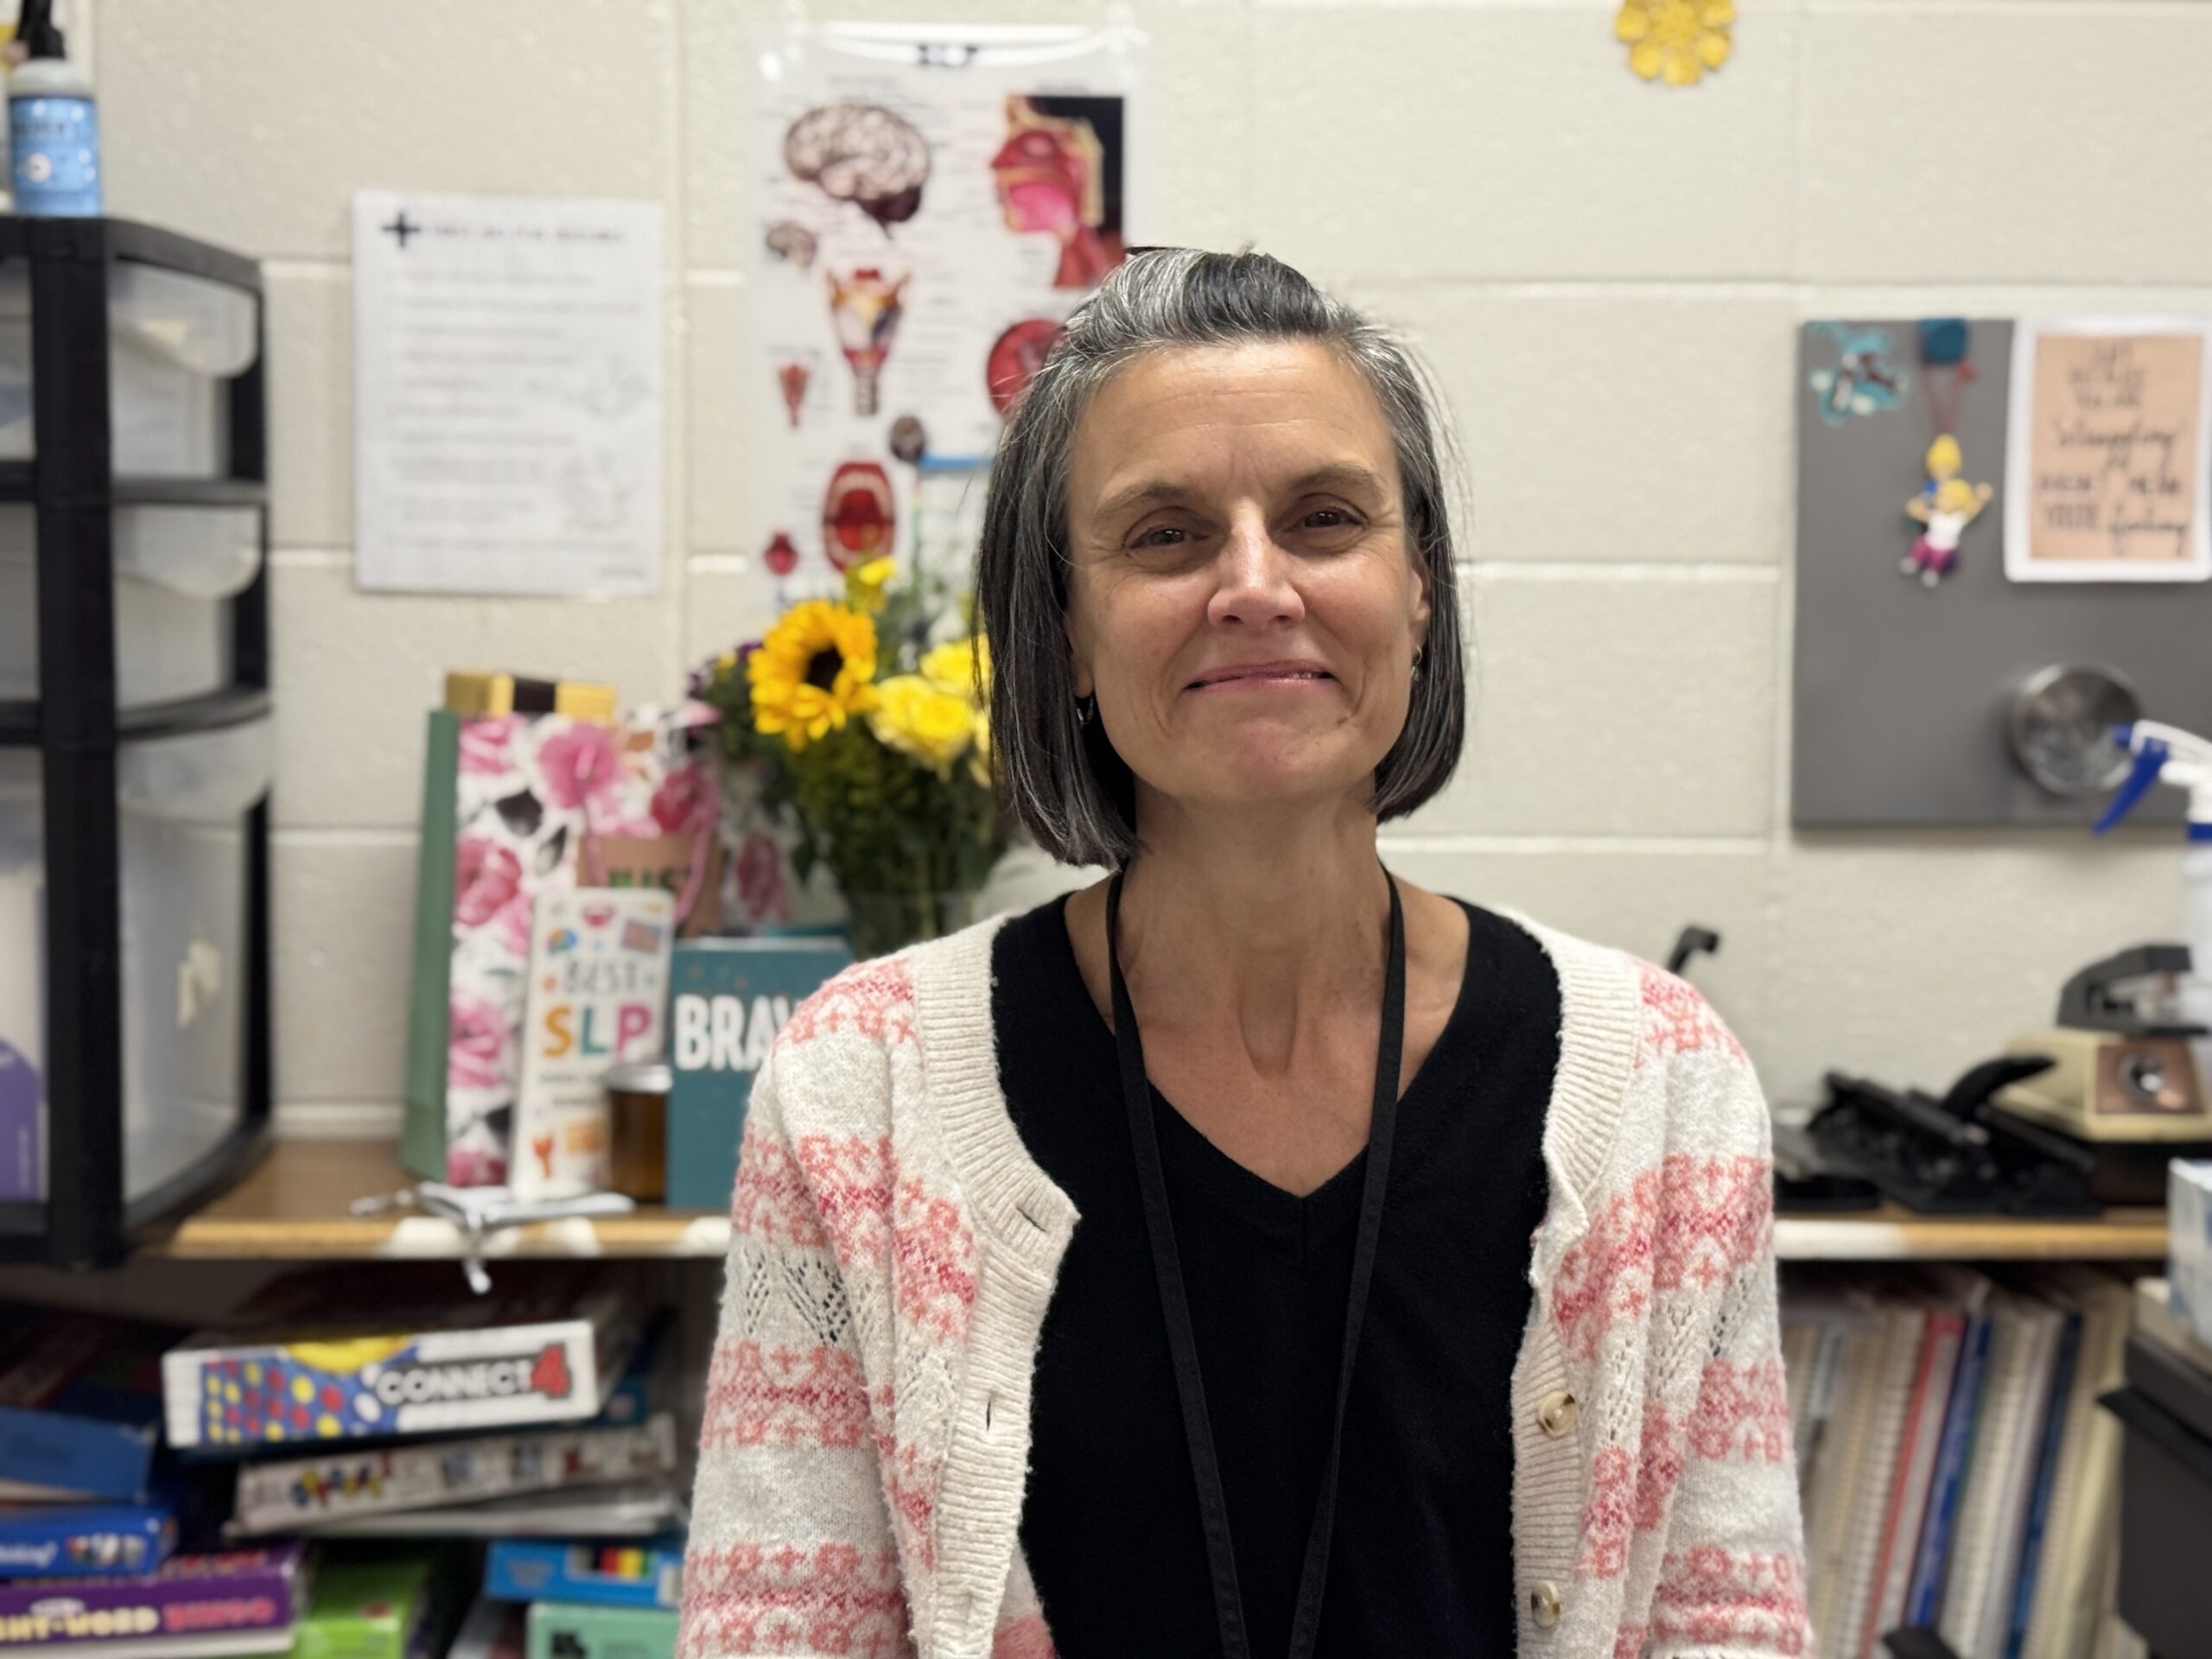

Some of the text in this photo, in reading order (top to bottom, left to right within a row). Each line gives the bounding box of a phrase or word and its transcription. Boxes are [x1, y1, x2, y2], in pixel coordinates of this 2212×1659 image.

[565, 960, 638, 994] BEST
[543, 1004, 652, 1059] SLP
[375, 1343, 571, 1406] CONNECT 4
[162, 1597, 276, 1632] BINGO
